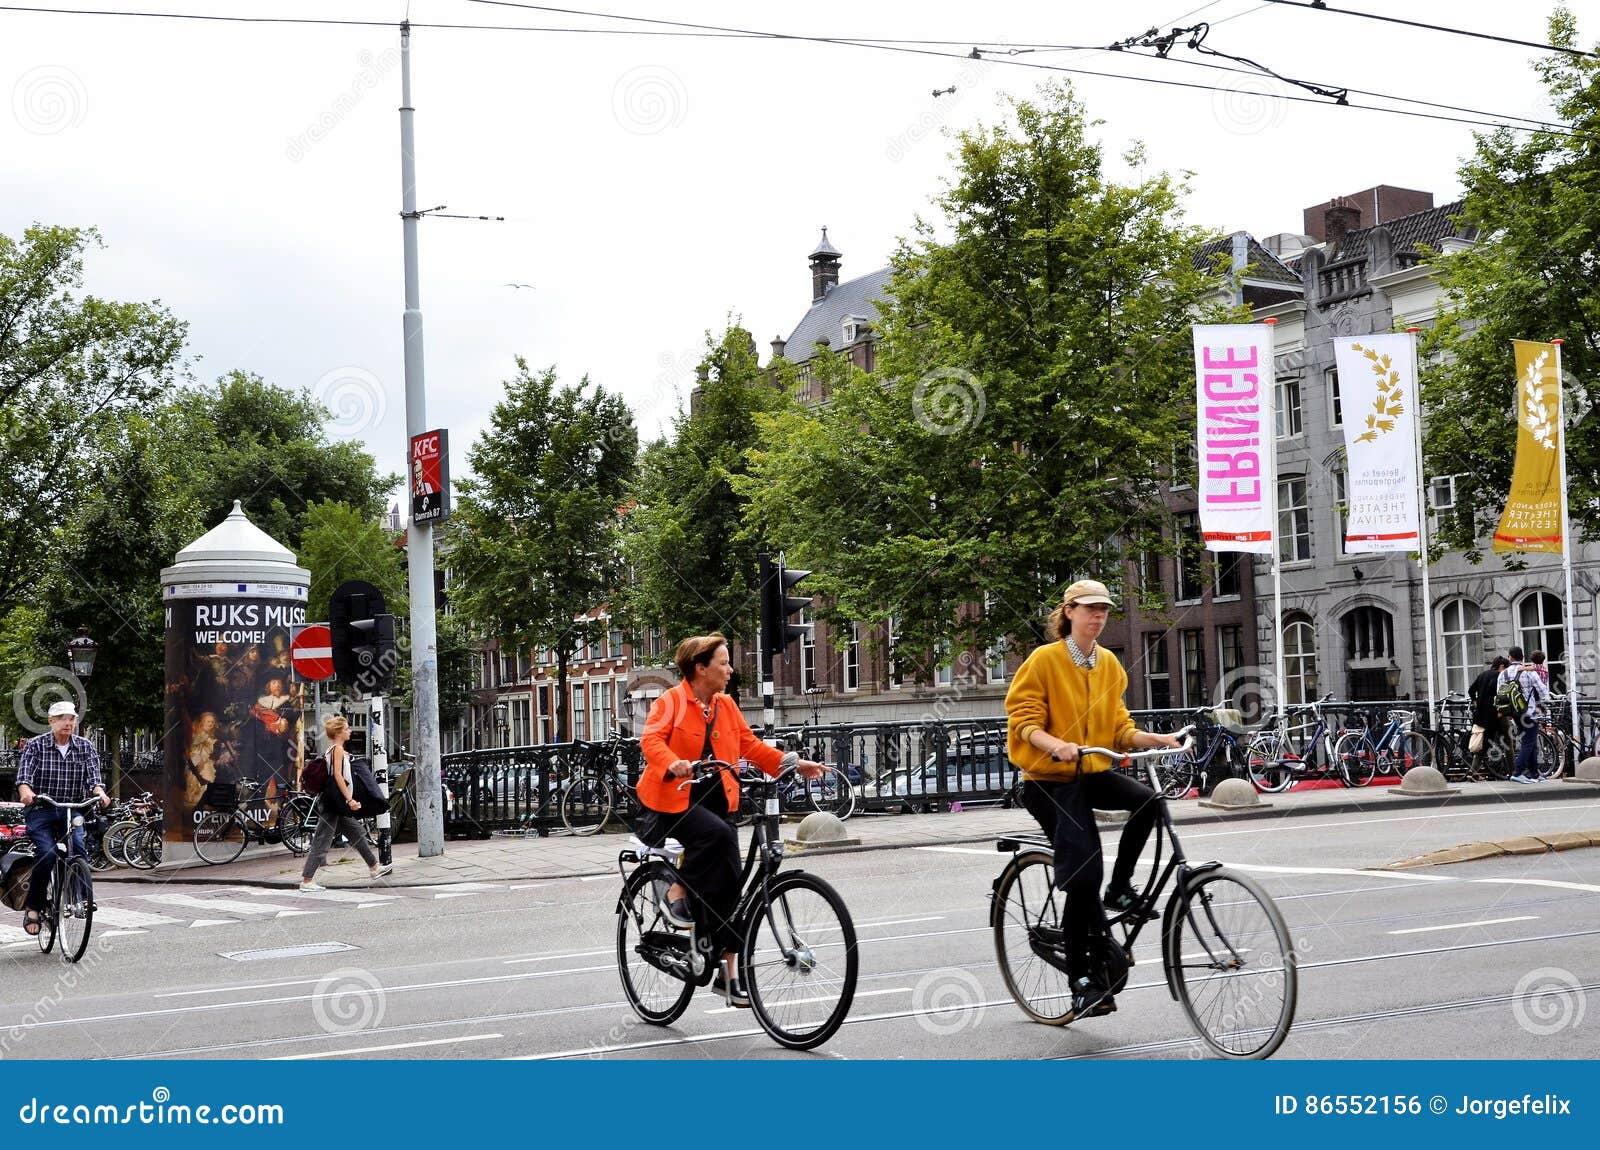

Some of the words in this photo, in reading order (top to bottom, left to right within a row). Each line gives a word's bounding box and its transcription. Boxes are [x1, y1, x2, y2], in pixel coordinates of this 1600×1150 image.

[413, 436, 438, 458] KFC
[414, 509, 433, 521] Damrak
[433, 507, 440, 517] 87
[196, 604, 259, 627] RIJKS
[195, 630, 265, 644] WELCOME!
